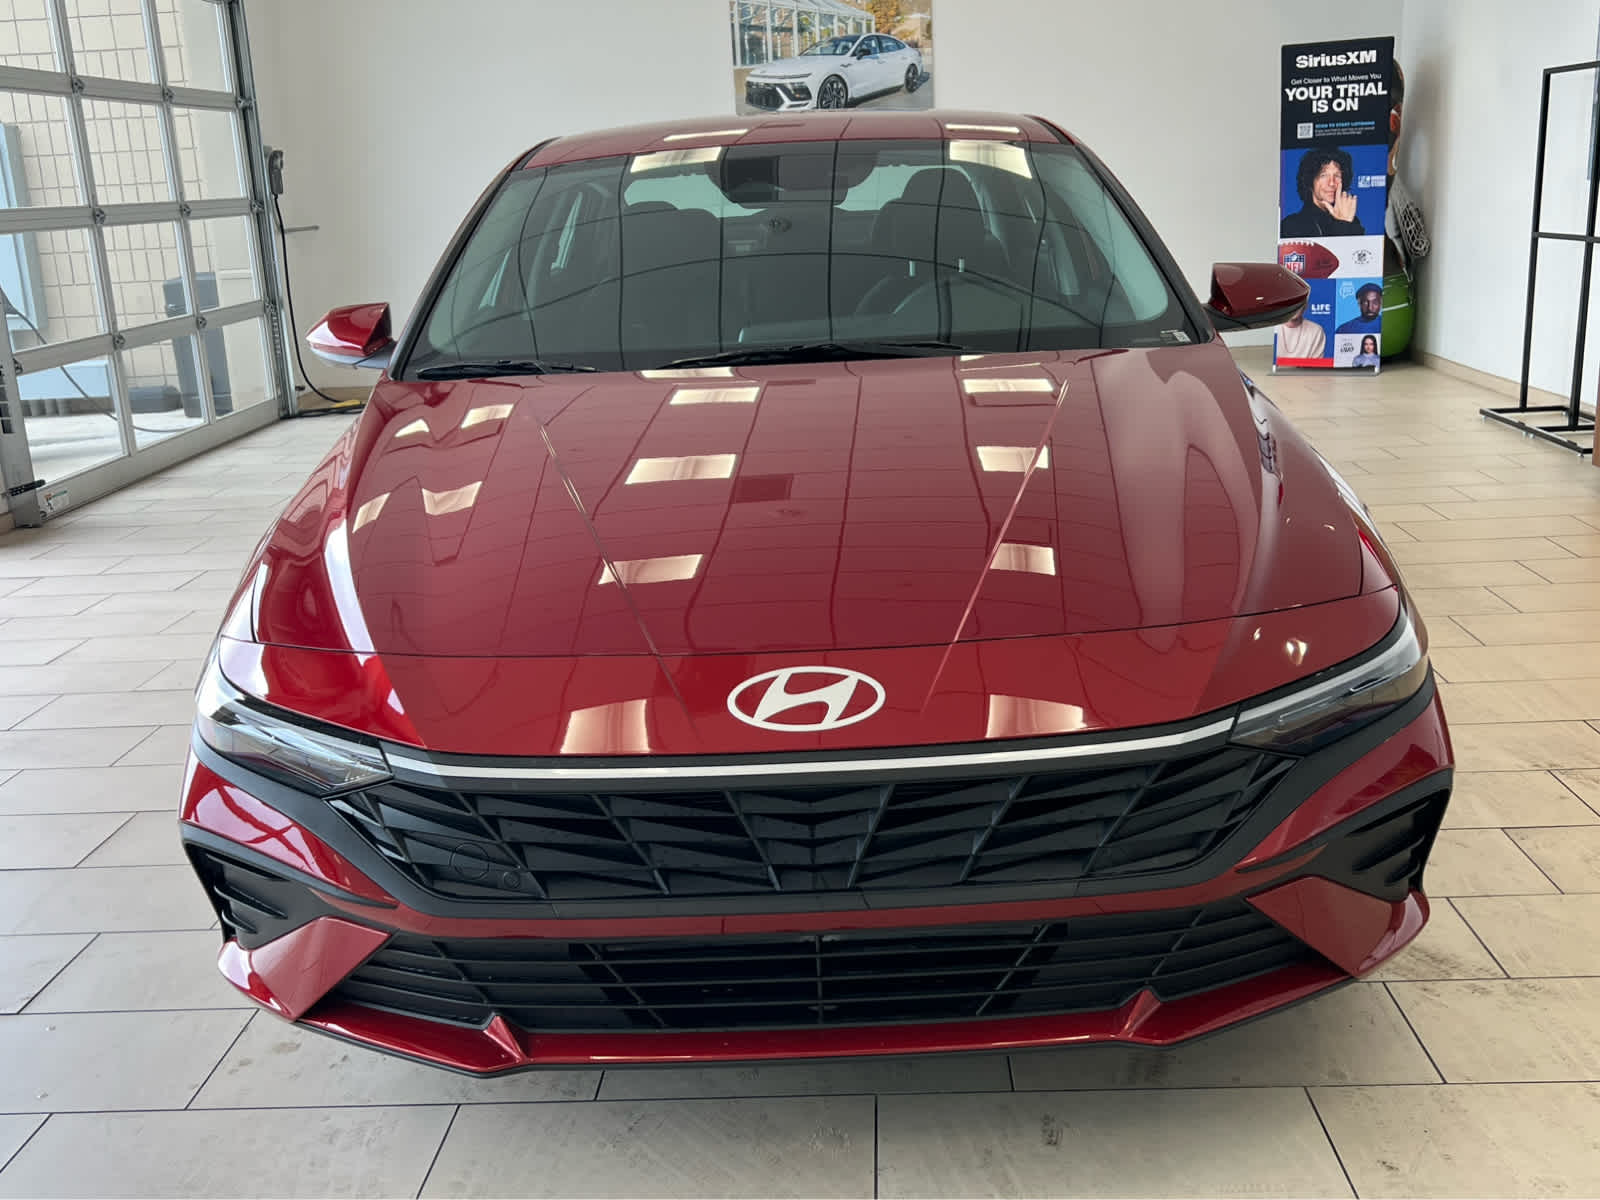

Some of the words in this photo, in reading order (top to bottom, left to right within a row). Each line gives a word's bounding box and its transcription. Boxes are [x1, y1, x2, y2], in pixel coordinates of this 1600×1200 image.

[1296, 50, 1376, 68] SiriusXM
[1285, 86, 1332, 101] YOUR
[1336, 82, 1388, 97] TRIAL
[1312, 101, 1328, 113] IS
[1332, 98, 1358, 112] ON
[1286, 262, 1304, 272] NFL
